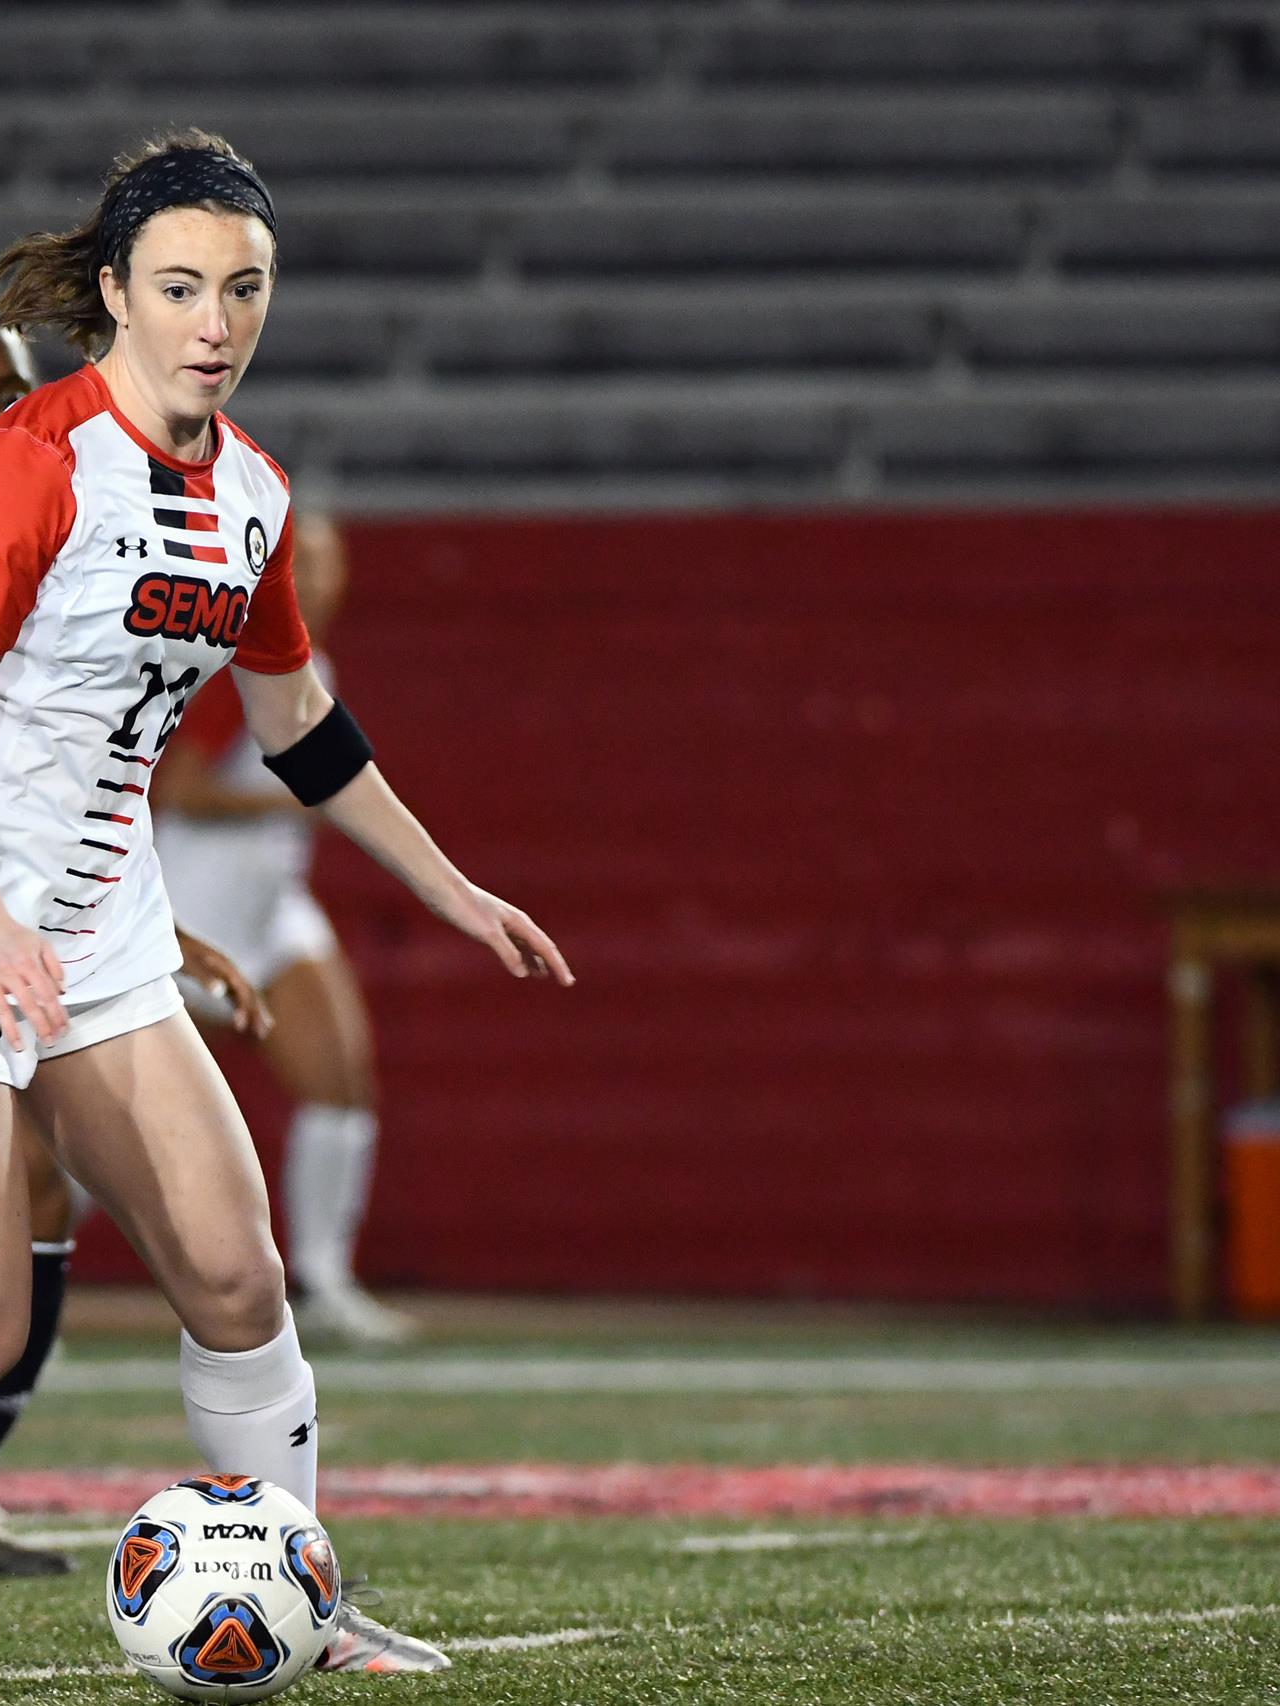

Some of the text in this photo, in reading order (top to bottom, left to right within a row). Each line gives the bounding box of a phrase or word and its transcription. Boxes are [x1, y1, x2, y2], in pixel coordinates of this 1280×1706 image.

[123, 572, 248, 648] SEMO
[203, 1523, 269, 1542] NCAA
[194, 1561, 274, 1582] Wilson
